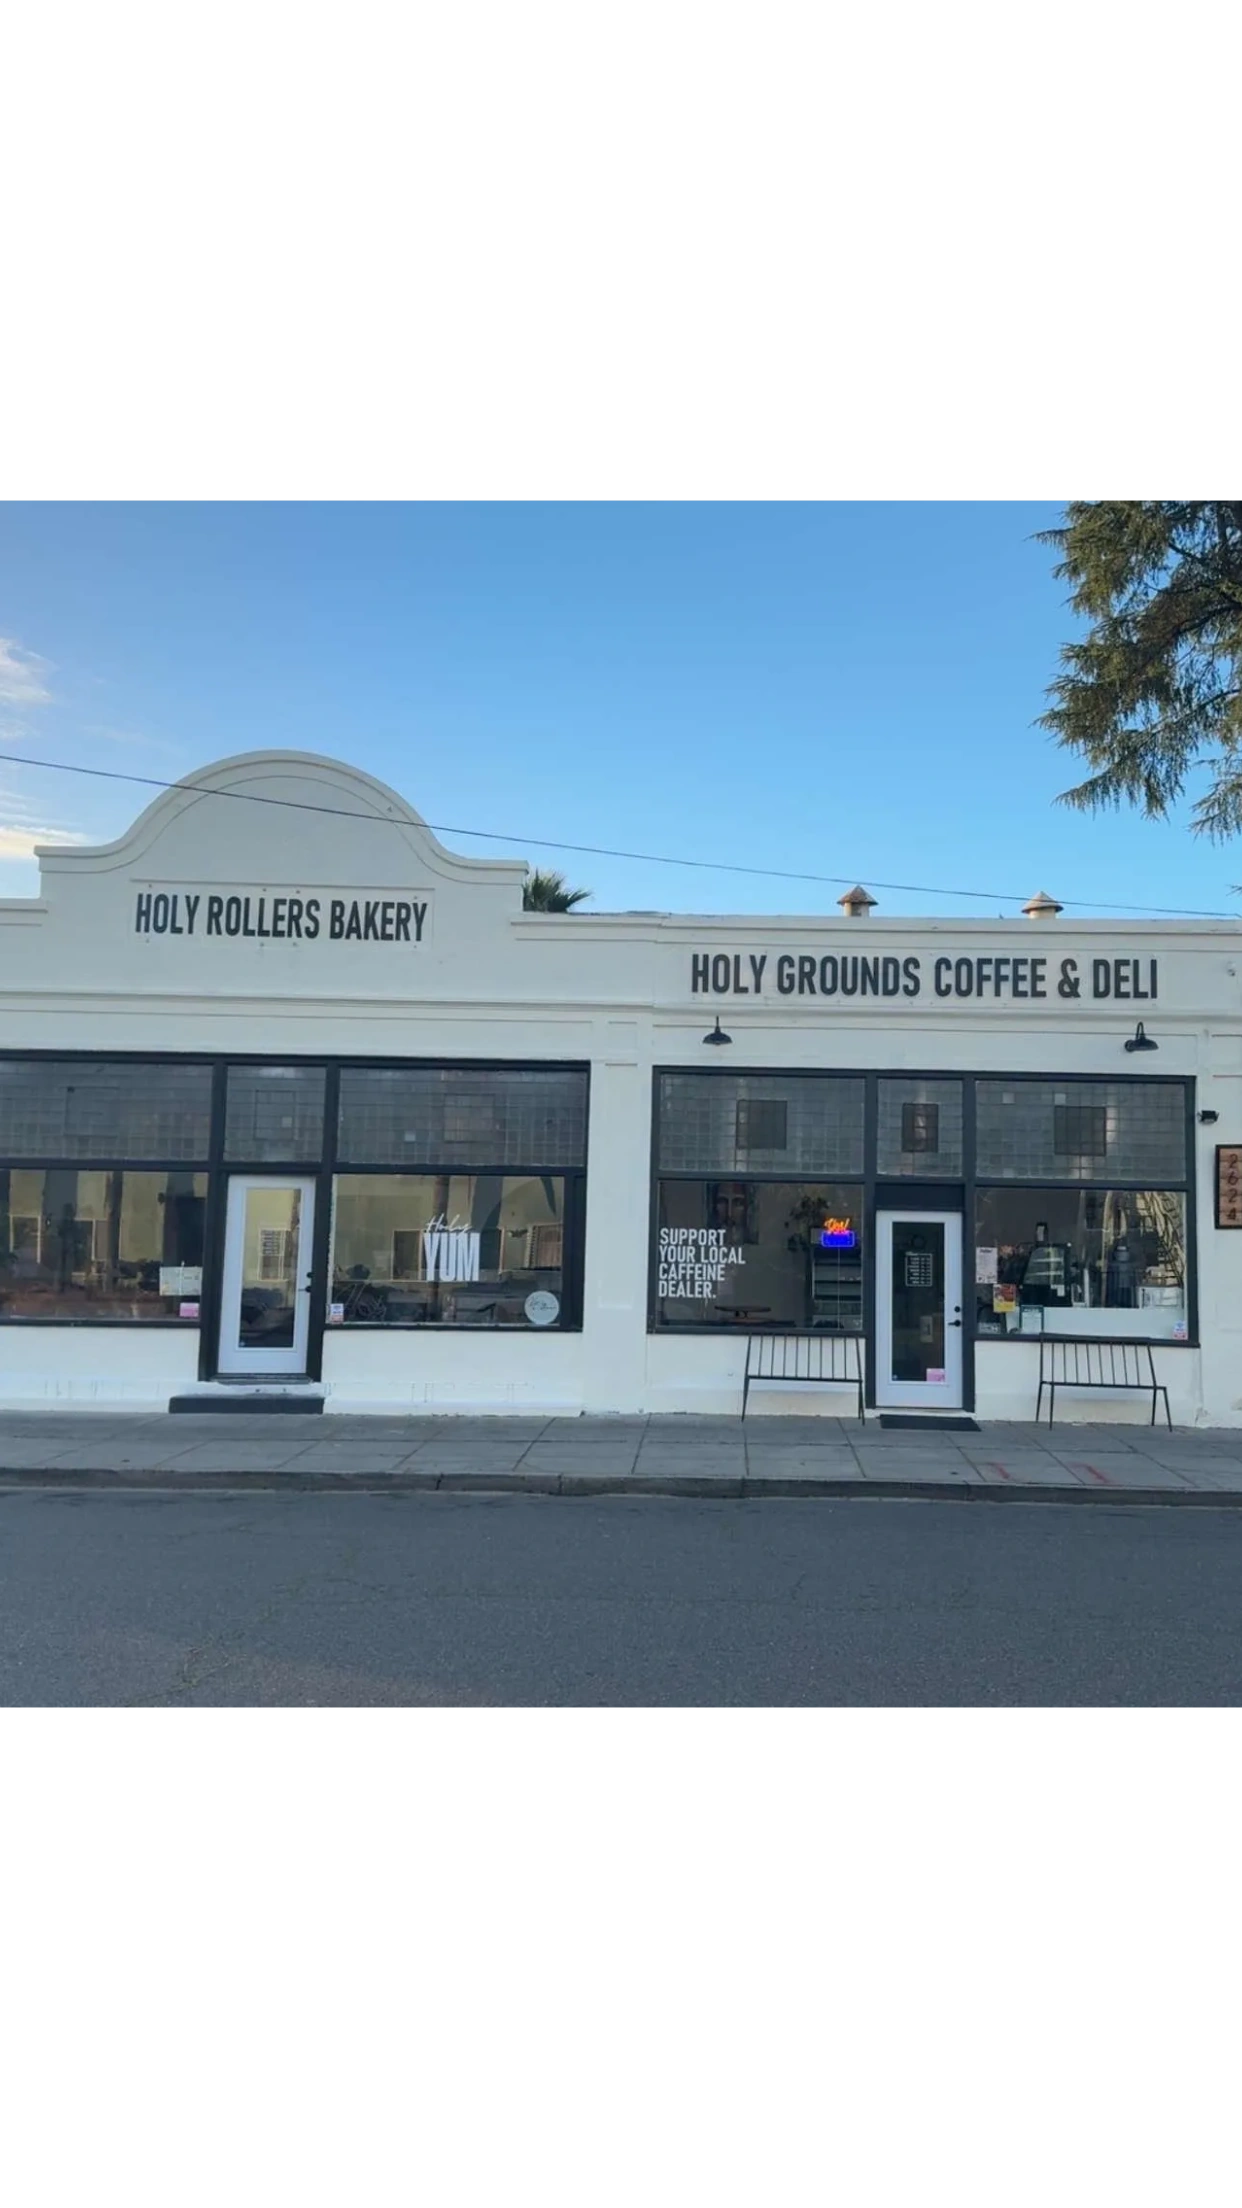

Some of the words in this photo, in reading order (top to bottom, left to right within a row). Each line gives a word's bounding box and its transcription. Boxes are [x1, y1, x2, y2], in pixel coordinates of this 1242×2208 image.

[135, 893, 200, 935] HOLY
[206, 896, 320, 939] ROLLERS
[329, 900, 428, 942] BAKERY
[691, 953, 768, 994] HOLY
[777, 955, 921, 998] GROUNDS
[934, 957, 1048, 998] COFFEE
[1057, 958, 1081, 999] &
[1092, 959, 1158, 999] DELI
[1226, 1153, 1239, 1220] 2624
[660, 1227, 726, 1246] SUPPORT
[423, 1232, 480, 1282] YUM
[659, 1245, 696, 1263] YOUR
[700, 1246, 746, 1264] LOCAL
[659, 1263, 725, 1281] CAFFEINE
[658, 1281, 716, 1298] DEALER.
